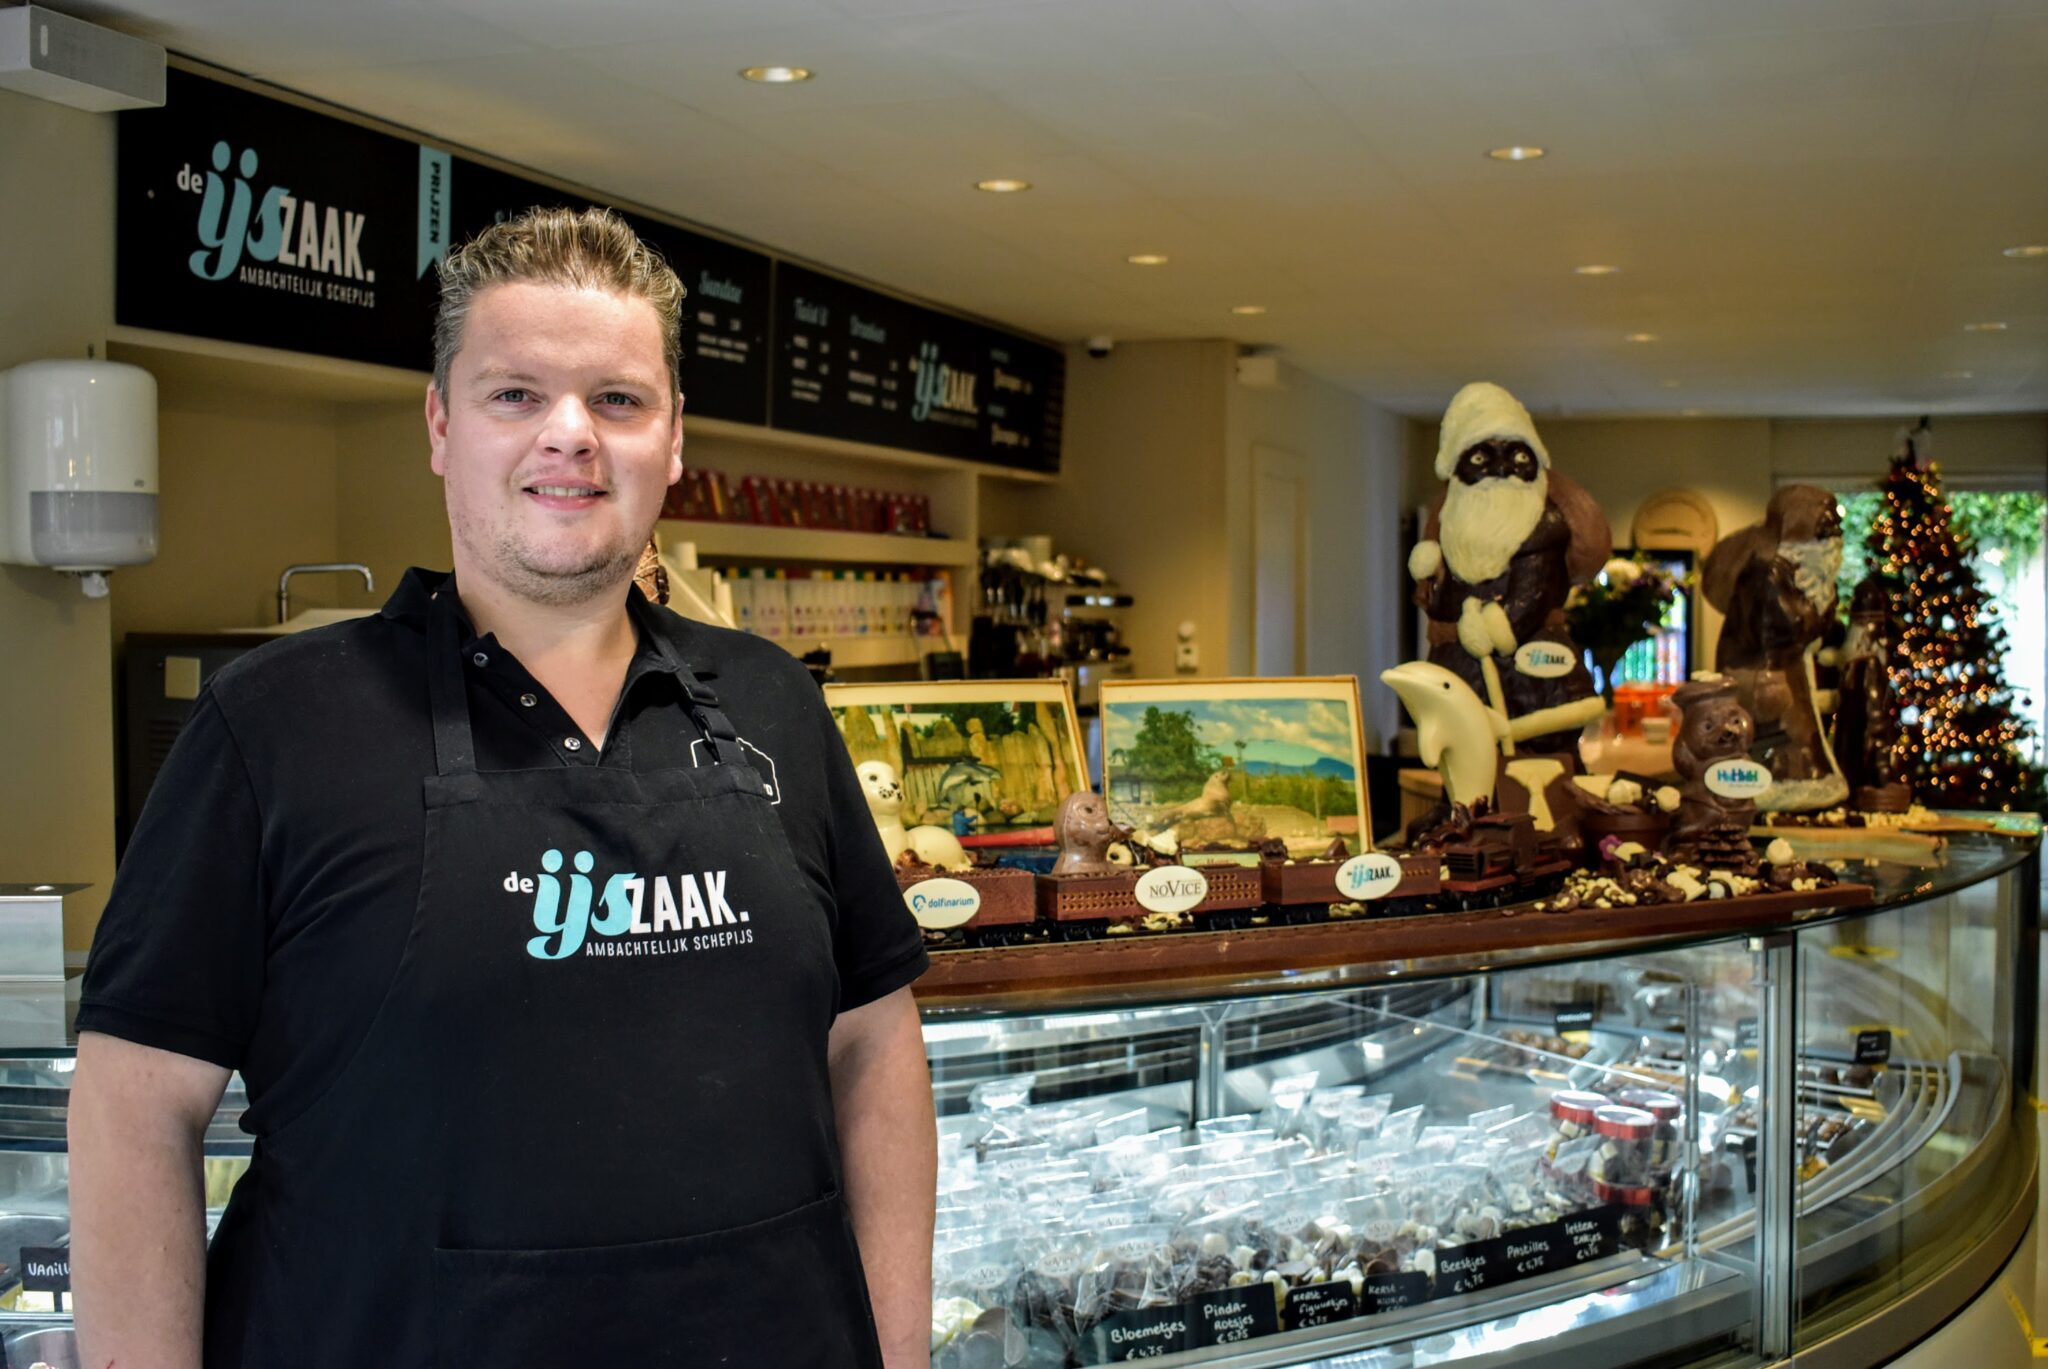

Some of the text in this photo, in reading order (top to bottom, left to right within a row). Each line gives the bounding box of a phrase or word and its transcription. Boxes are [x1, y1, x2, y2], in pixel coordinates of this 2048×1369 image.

[176, 162, 204, 194] de
[429, 161, 441, 244] PRIJZEN
[239, 265, 376, 309] AMBACHTELIJK SCHEPIJS
[503, 871, 534, 894] de
[928, 897, 975, 909] dolfinarium
[586, 928, 754, 958] AMBACHTELIJK SCHEPIJS
[1440, 1255, 1487, 1274] Beestjes
[1110, 1320, 1187, 1344] Bloemetjes
